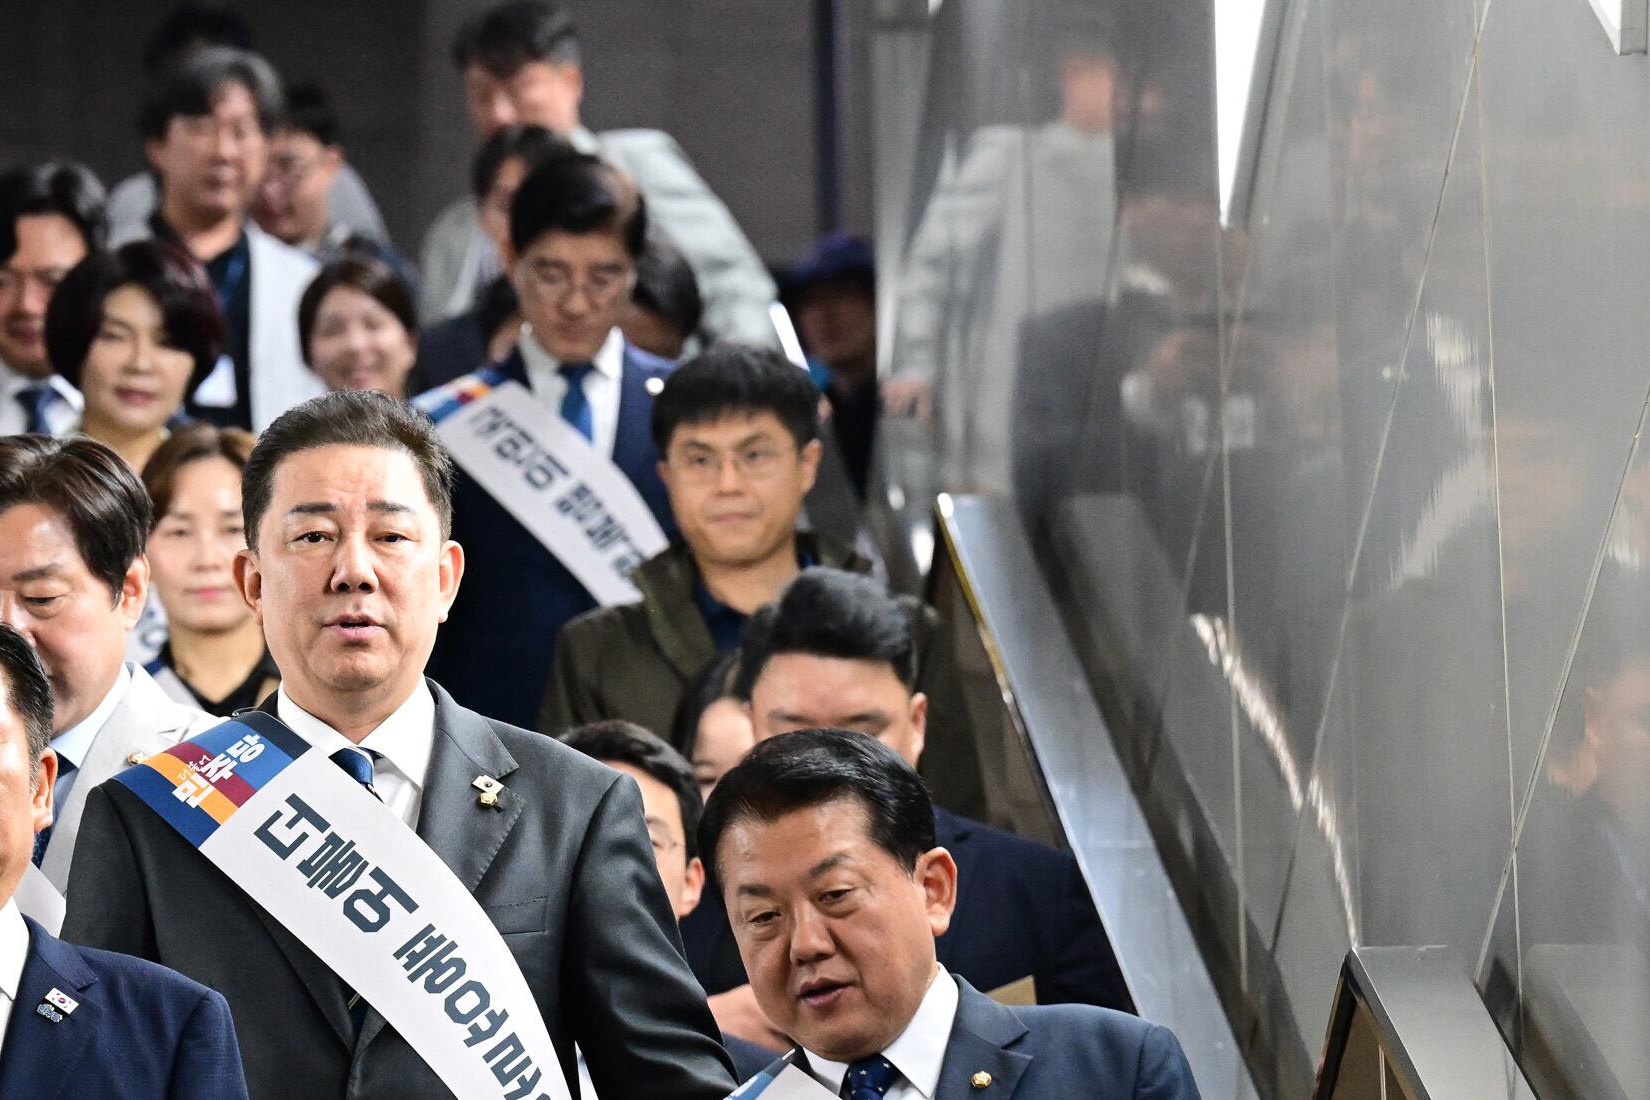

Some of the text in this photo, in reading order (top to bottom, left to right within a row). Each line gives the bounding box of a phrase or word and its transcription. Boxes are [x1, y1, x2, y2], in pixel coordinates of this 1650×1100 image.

[171, 734, 266, 809] 민주당
[178, 754, 212, 781] 더불어
[253, 792, 420, 933] 더불어
